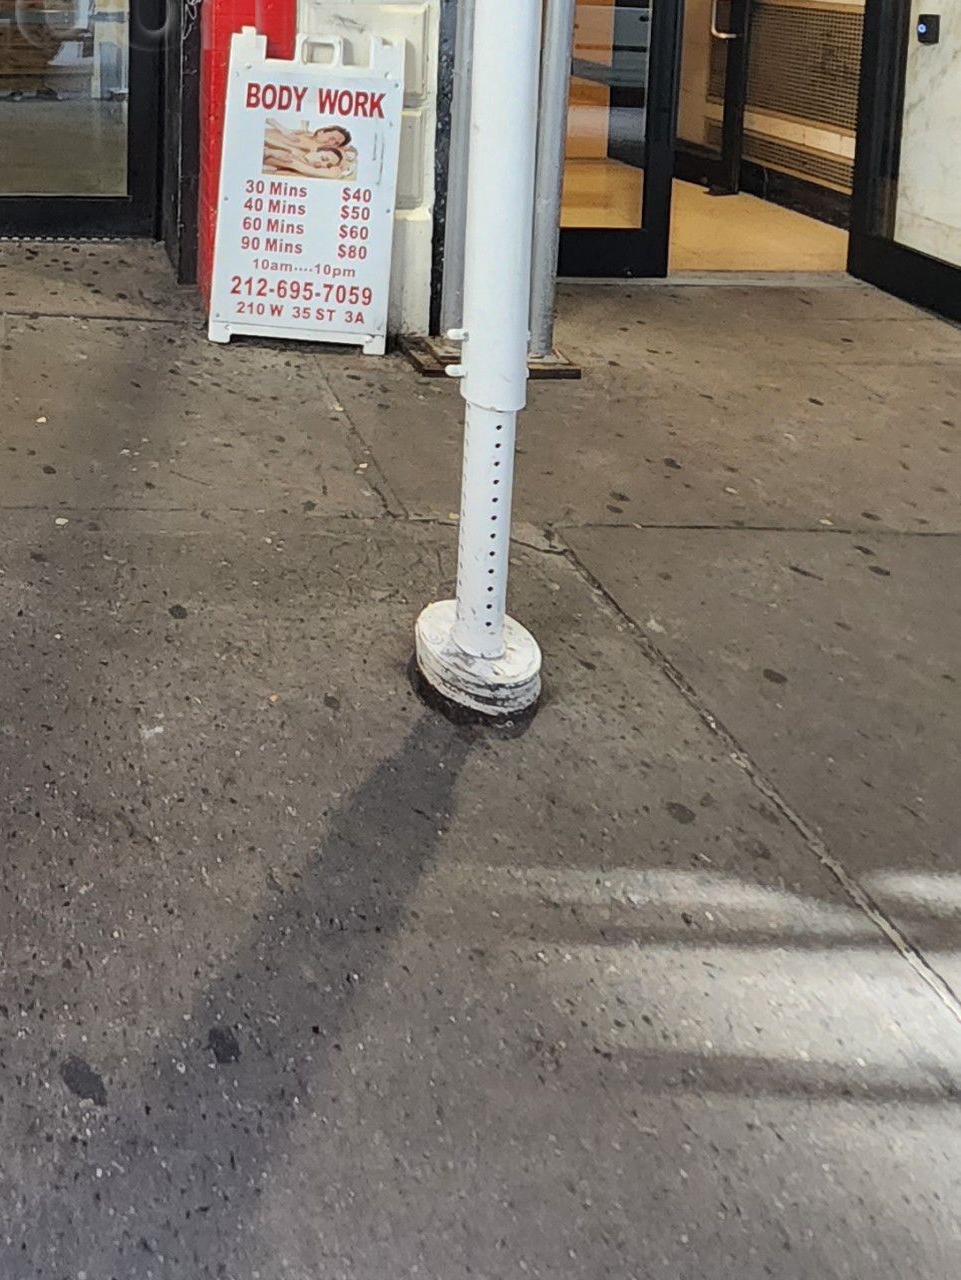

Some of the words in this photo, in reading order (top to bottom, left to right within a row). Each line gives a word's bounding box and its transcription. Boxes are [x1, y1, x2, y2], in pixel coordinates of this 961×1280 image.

[245, 82, 308, 112] BODY
[317, 88, 386, 118] WORK
[245, 180, 265, 194] 30
[269, 181, 308, 198] Mins
[341, 187, 372, 203] $40
[243, 197, 264, 212] 40
[267, 199, 306, 215] Mins
[340, 205, 370, 221] $50
[242, 217, 262, 231] 60
[266, 218, 304, 235] Mins
[338, 224, 369, 240] $60
[240, 236, 260, 250] 90
[264, 237, 303, 254] Mins
[337, 244, 367, 260] $80
[230, 275, 373, 306] 212-695-7059
[237, 301, 265, 316] 210
[269, 304, 284, 317] W
[292, 306, 311, 320] 35
[315, 308, 336, 322] ST
[344, 311, 365, 324] 3A
